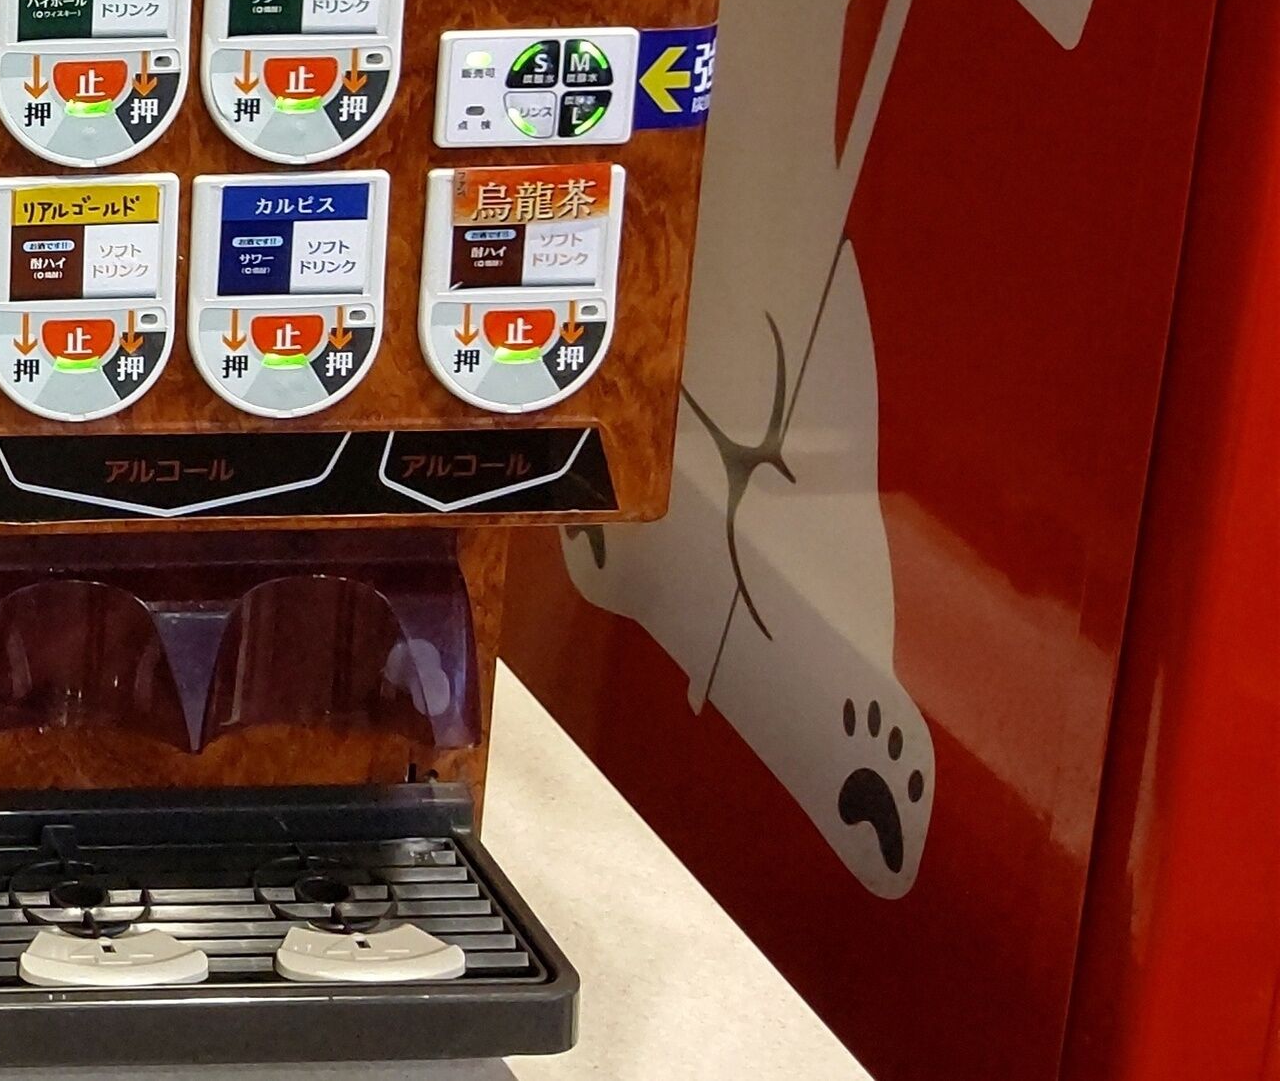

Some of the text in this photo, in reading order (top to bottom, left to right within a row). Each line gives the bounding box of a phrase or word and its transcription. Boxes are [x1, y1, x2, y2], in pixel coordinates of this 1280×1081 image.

[102, 2, 160, 18] ドリンク
[312, 0, 370, 14] ドリンク
[534, 53, 548, 73] S
[570, 53, 590, 71] M
[76, 69, 106, 97] 止
[285, 66, 315, 94] 止
[24, 103, 51, 127] 押
[130, 98, 159, 125] 押
[234, 98, 261, 122] 押
[339, 95, 368, 121] 押
[22, 195, 141, 223] リアルゴールド
[254, 196, 336, 215] カルピス
[471, 177, 598, 223] 烏龍茶
[99, 243, 142, 259] ソフト
[307, 239, 350, 255] ソフト
[470, 246, 507, 259] 酎ハイ
[540, 233, 583, 248] ソフト
[29, 257, 67, 270] 酎ハイ
[92, 263, 149, 279] ドリンク
[239, 253, 275, 265] サワー
[299, 259, 357, 275] ドリンク
[532, 252, 589, 267] ドリンク
[64, 327, 93, 354] 止
[272, 323, 301, 350] 止
[504, 317, 534, 345] 止
[117, 356, 145, 381] 押
[222, 354, 249, 379] 押
[325, 351, 354, 377] 押
[453, 349, 480, 373] 押
[556, 346, 584, 371] 押
[13, 359, 40, 383] 押
[105, 459, 234, 483] アルコール
[401, 454, 531, 478] アルコール
